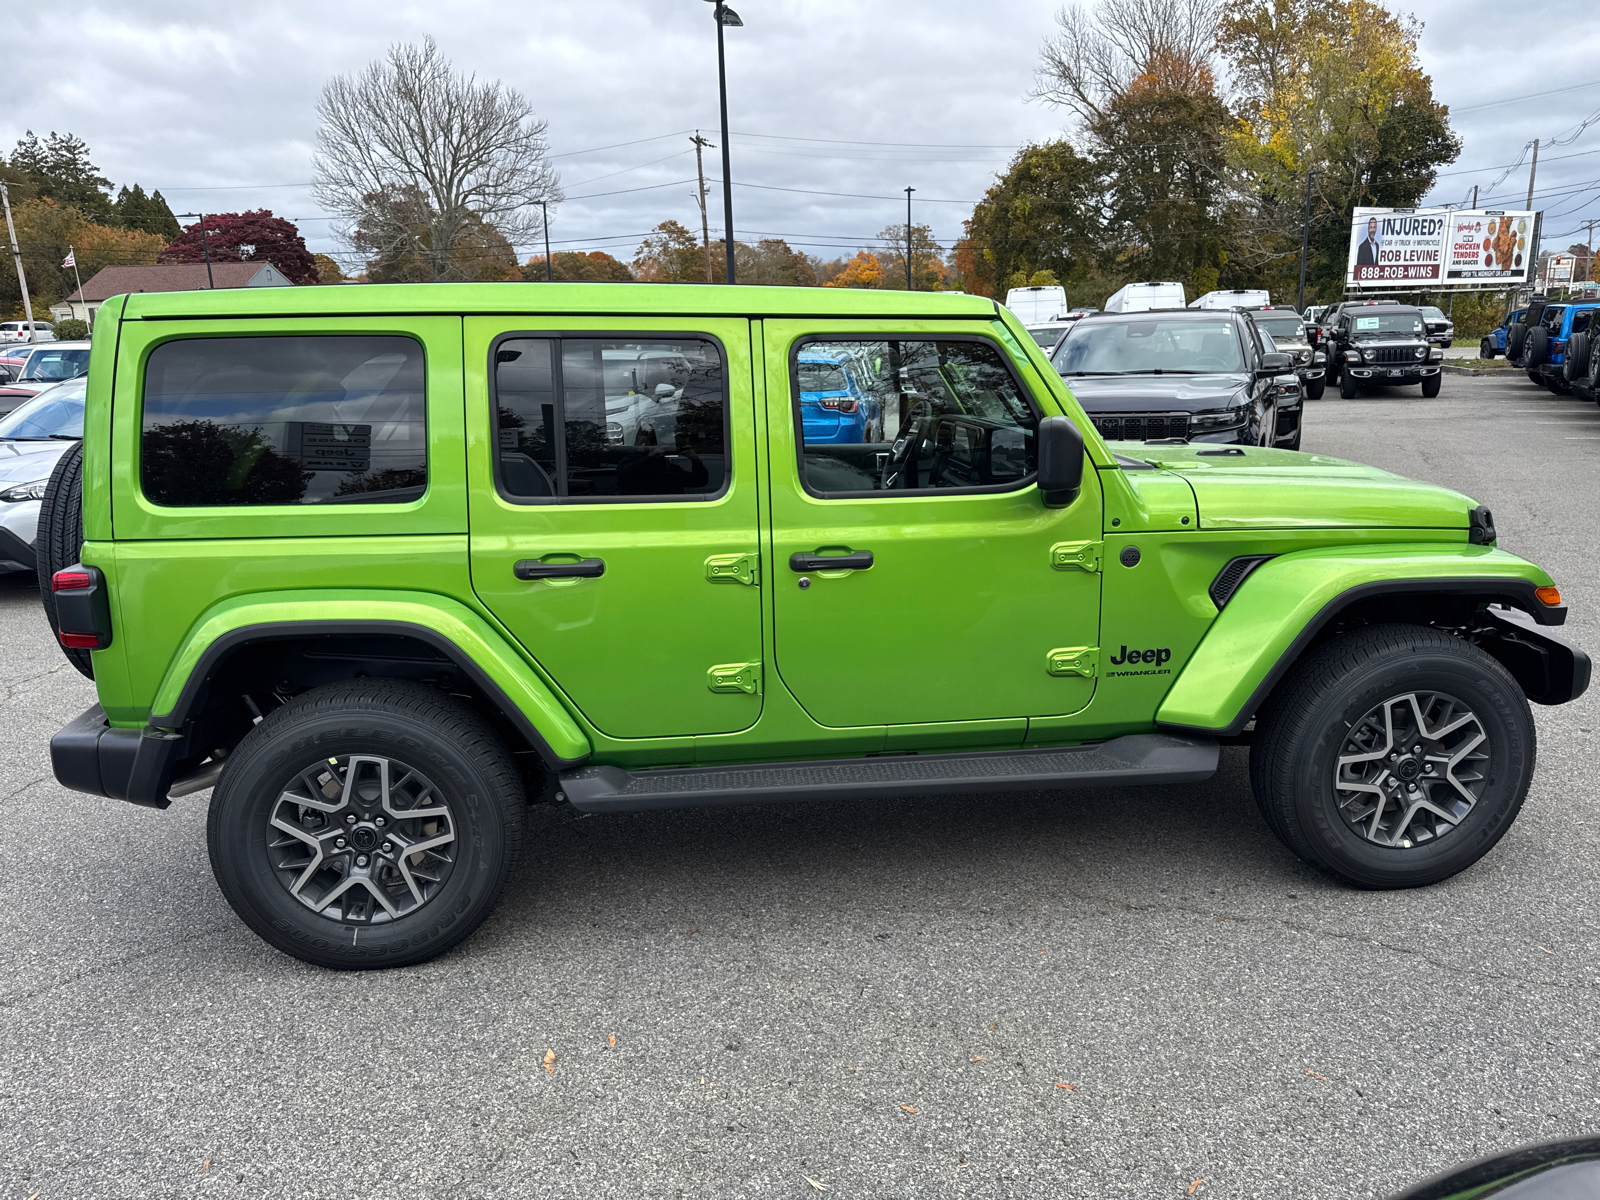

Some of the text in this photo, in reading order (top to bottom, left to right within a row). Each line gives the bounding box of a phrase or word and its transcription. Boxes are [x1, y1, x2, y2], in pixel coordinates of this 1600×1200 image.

[1382, 218, 1443, 236] INJURED?
[1457, 221, 1474, 233] Wendy's
[1380, 250, 1439, 262] ROB LEVINE
[1453, 251, 1479, 259] TENDERS
[1361, 266, 1432, 279] 888-ROB-WINS
[1110, 644, 1171, 667] Jeep
[1116, 669, 1171, 677] WRANGLER
[264, 727, 425, 774] DUELER
[1472, 679, 1525, 846] BRIDGESTONE
[271, 892, 473, 958] BRIDGESTONE
